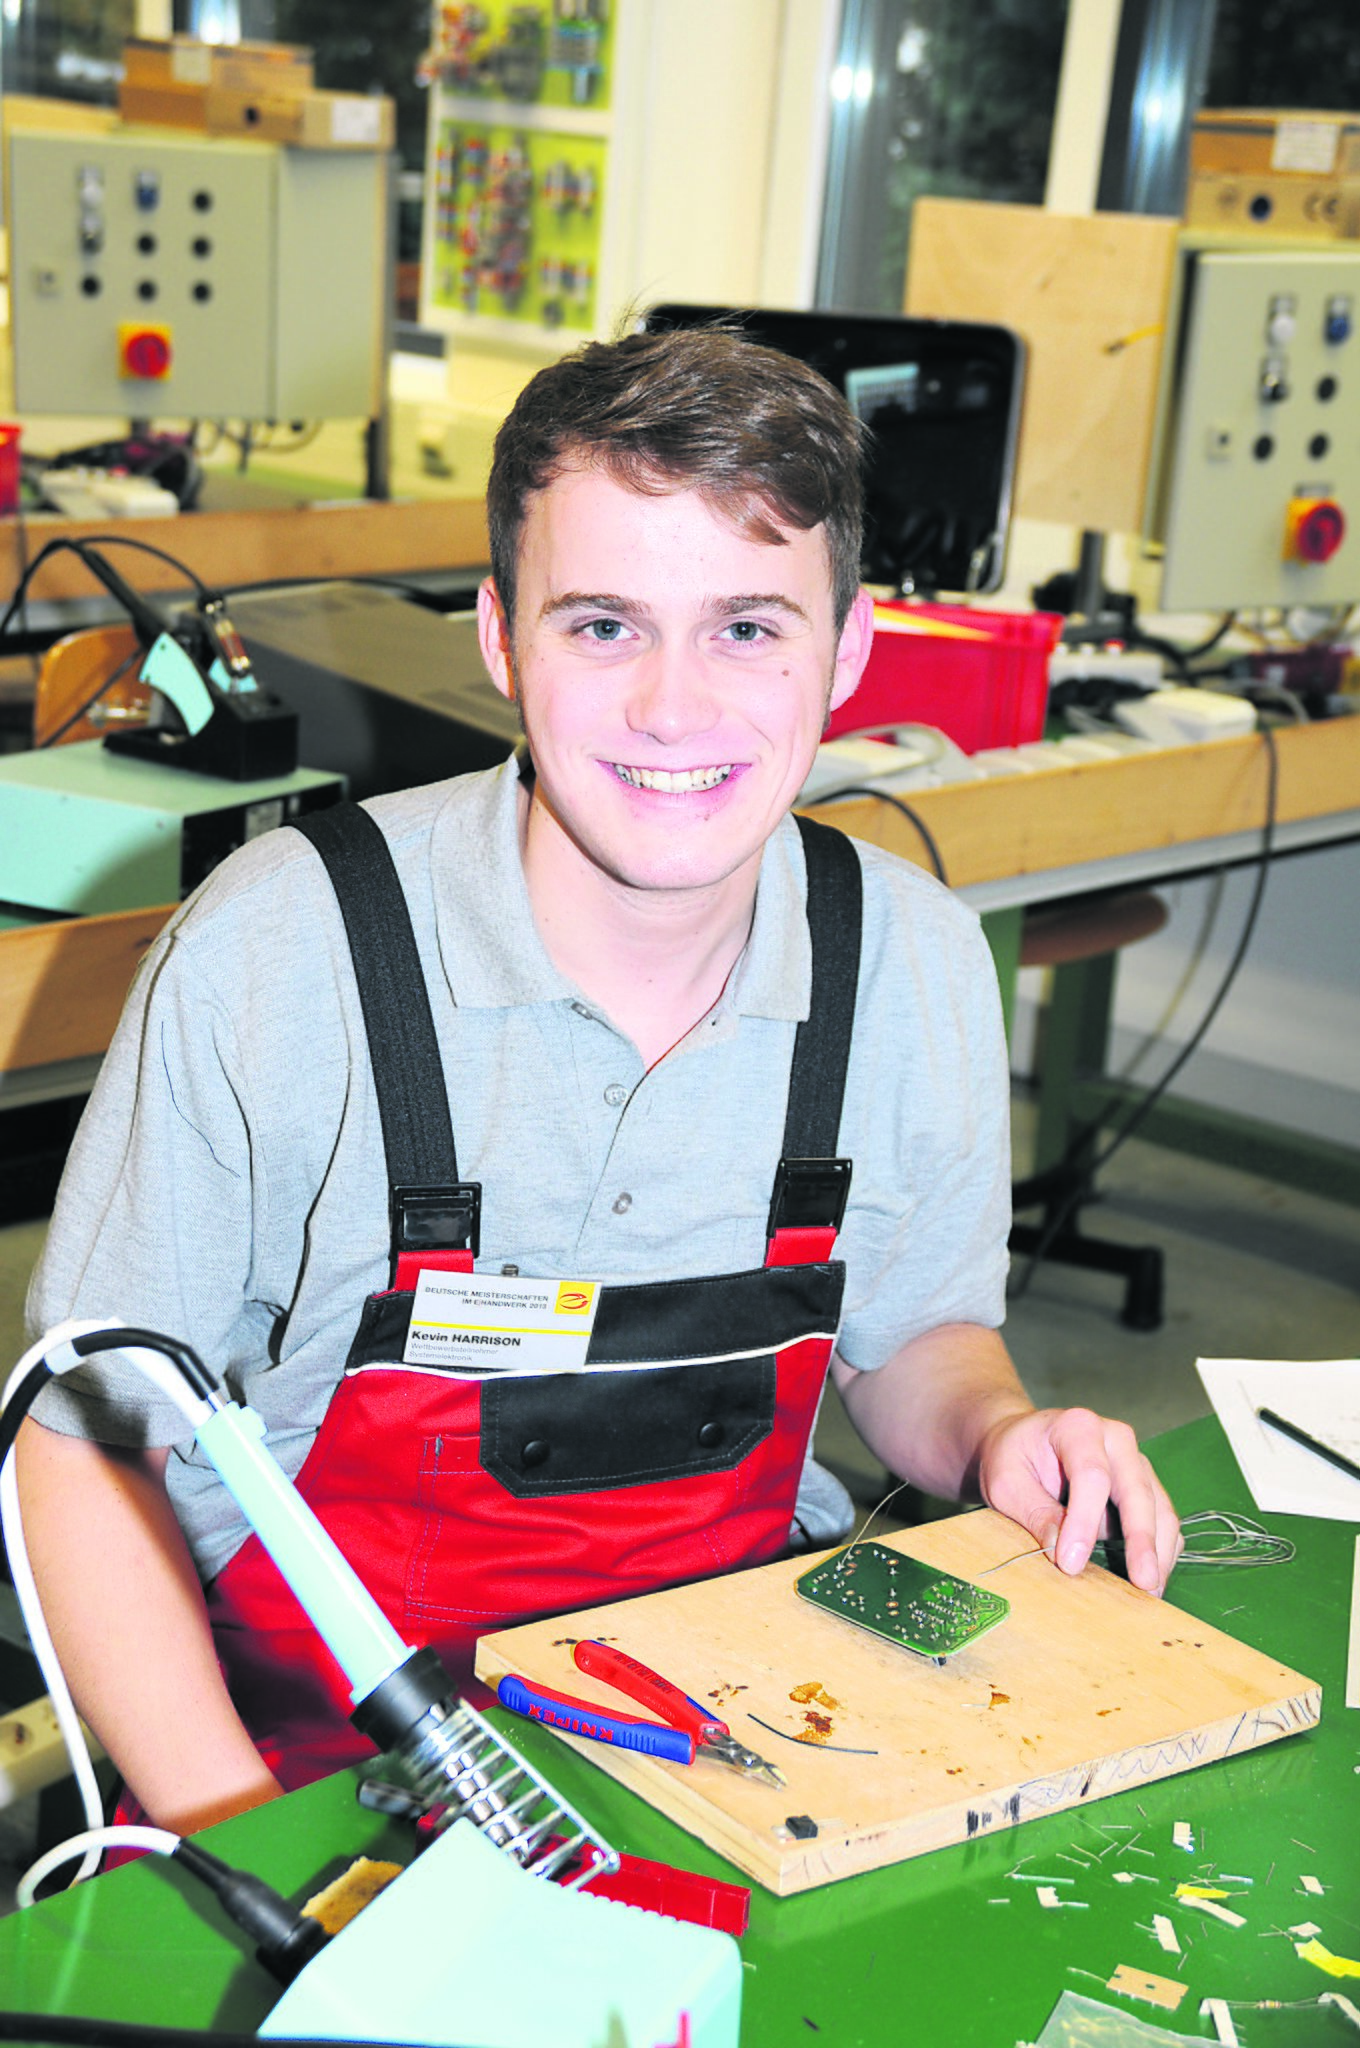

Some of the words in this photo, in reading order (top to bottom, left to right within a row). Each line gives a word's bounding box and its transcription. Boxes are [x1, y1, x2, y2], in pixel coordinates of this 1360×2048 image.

[425, 1286, 469, 1297] DEUTSCHE
[471, 1290, 549, 1302] MEISTERSCHAFTEN
[529, 1302, 547, 1310] 2013
[411, 1330, 448, 1342] Kevin
[452, 1333, 521, 1347] HARRISON
[528, 1703, 614, 1742] KNIPEX
